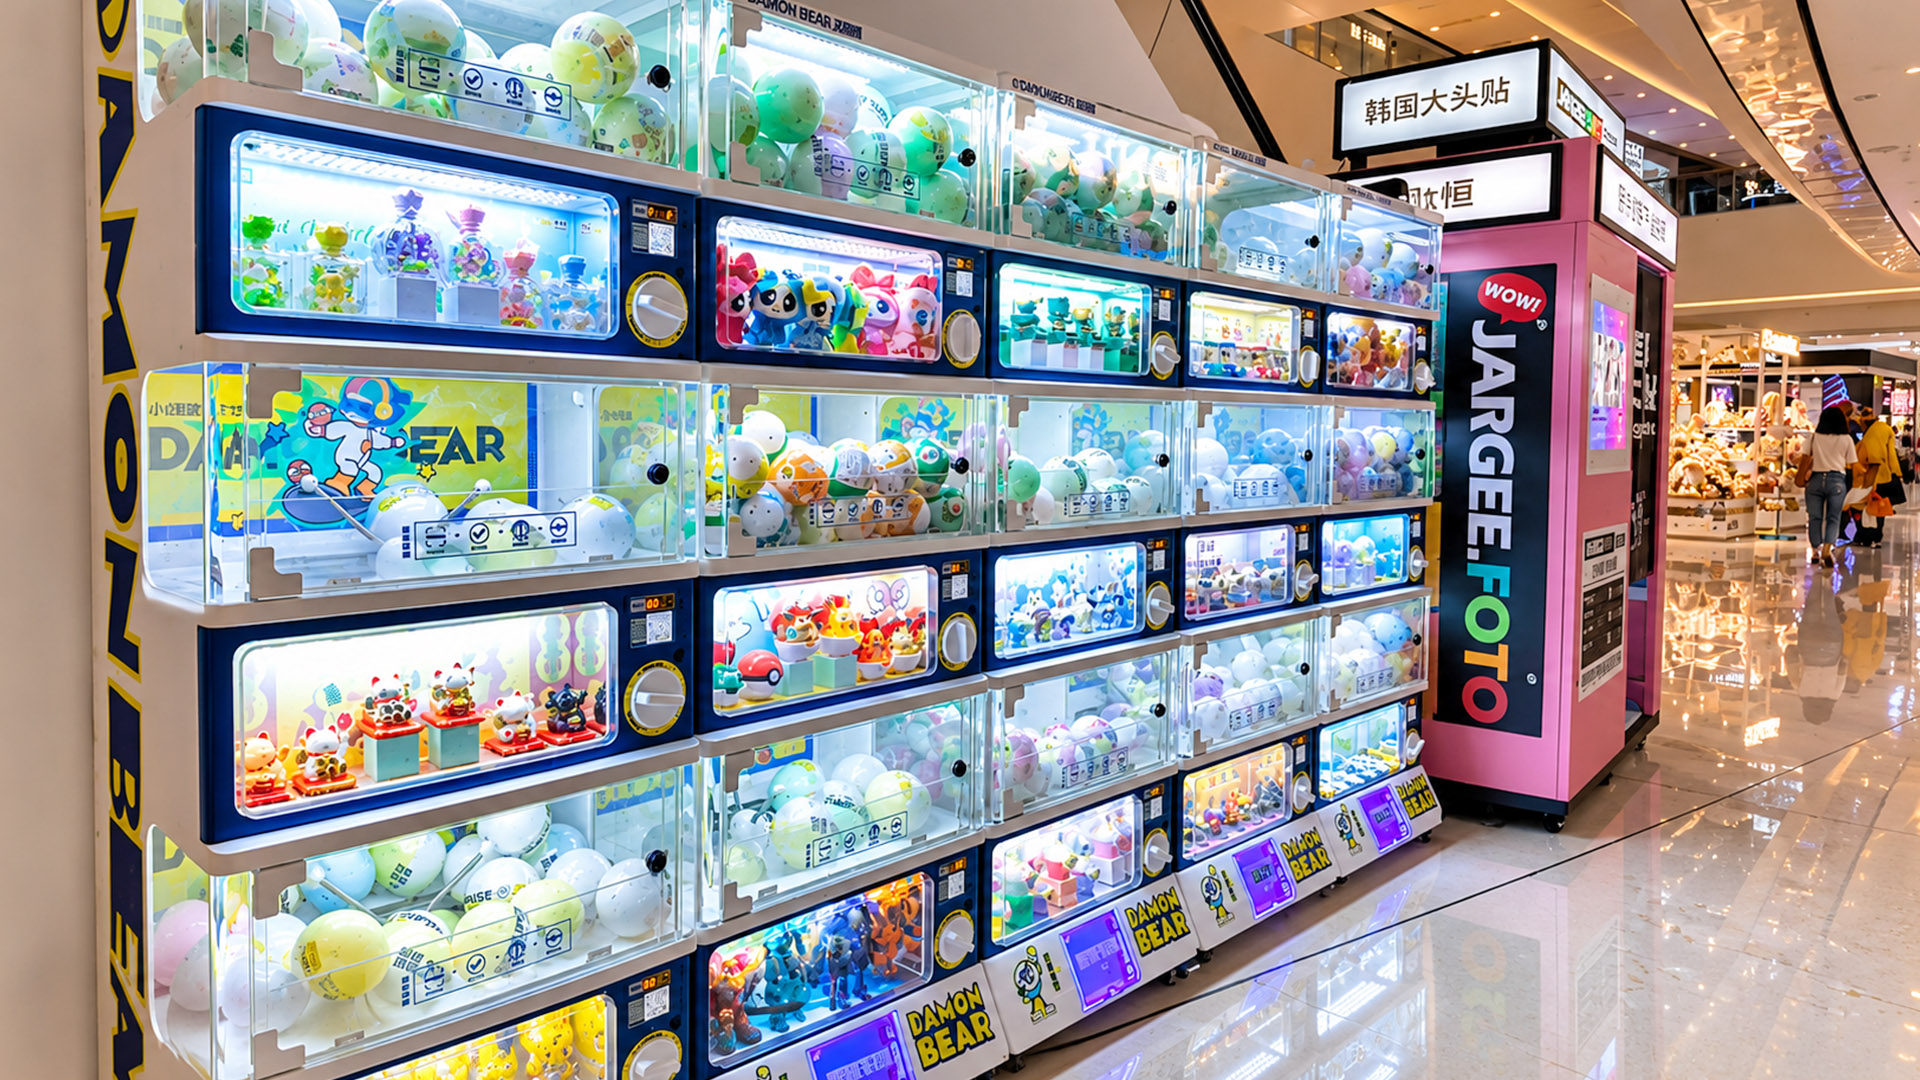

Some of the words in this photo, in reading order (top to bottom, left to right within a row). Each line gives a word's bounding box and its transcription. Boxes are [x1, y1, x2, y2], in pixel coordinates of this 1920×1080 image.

[799, 6, 832, 29] BEAR
[1365, 76, 1510, 125] 韩国大头贴
[1483, 280, 1543, 314] WOW!
[1461, 319, 1519, 725] JARGEE.FOTO
[1288, 843, 1333, 884] BEAR
[1125, 886, 1182, 928] DAMON
[1133, 910, 1192, 957] BEAR
[907, 982, 985, 1037] DAMON
[915, 1009, 996, 1071] BEAR
